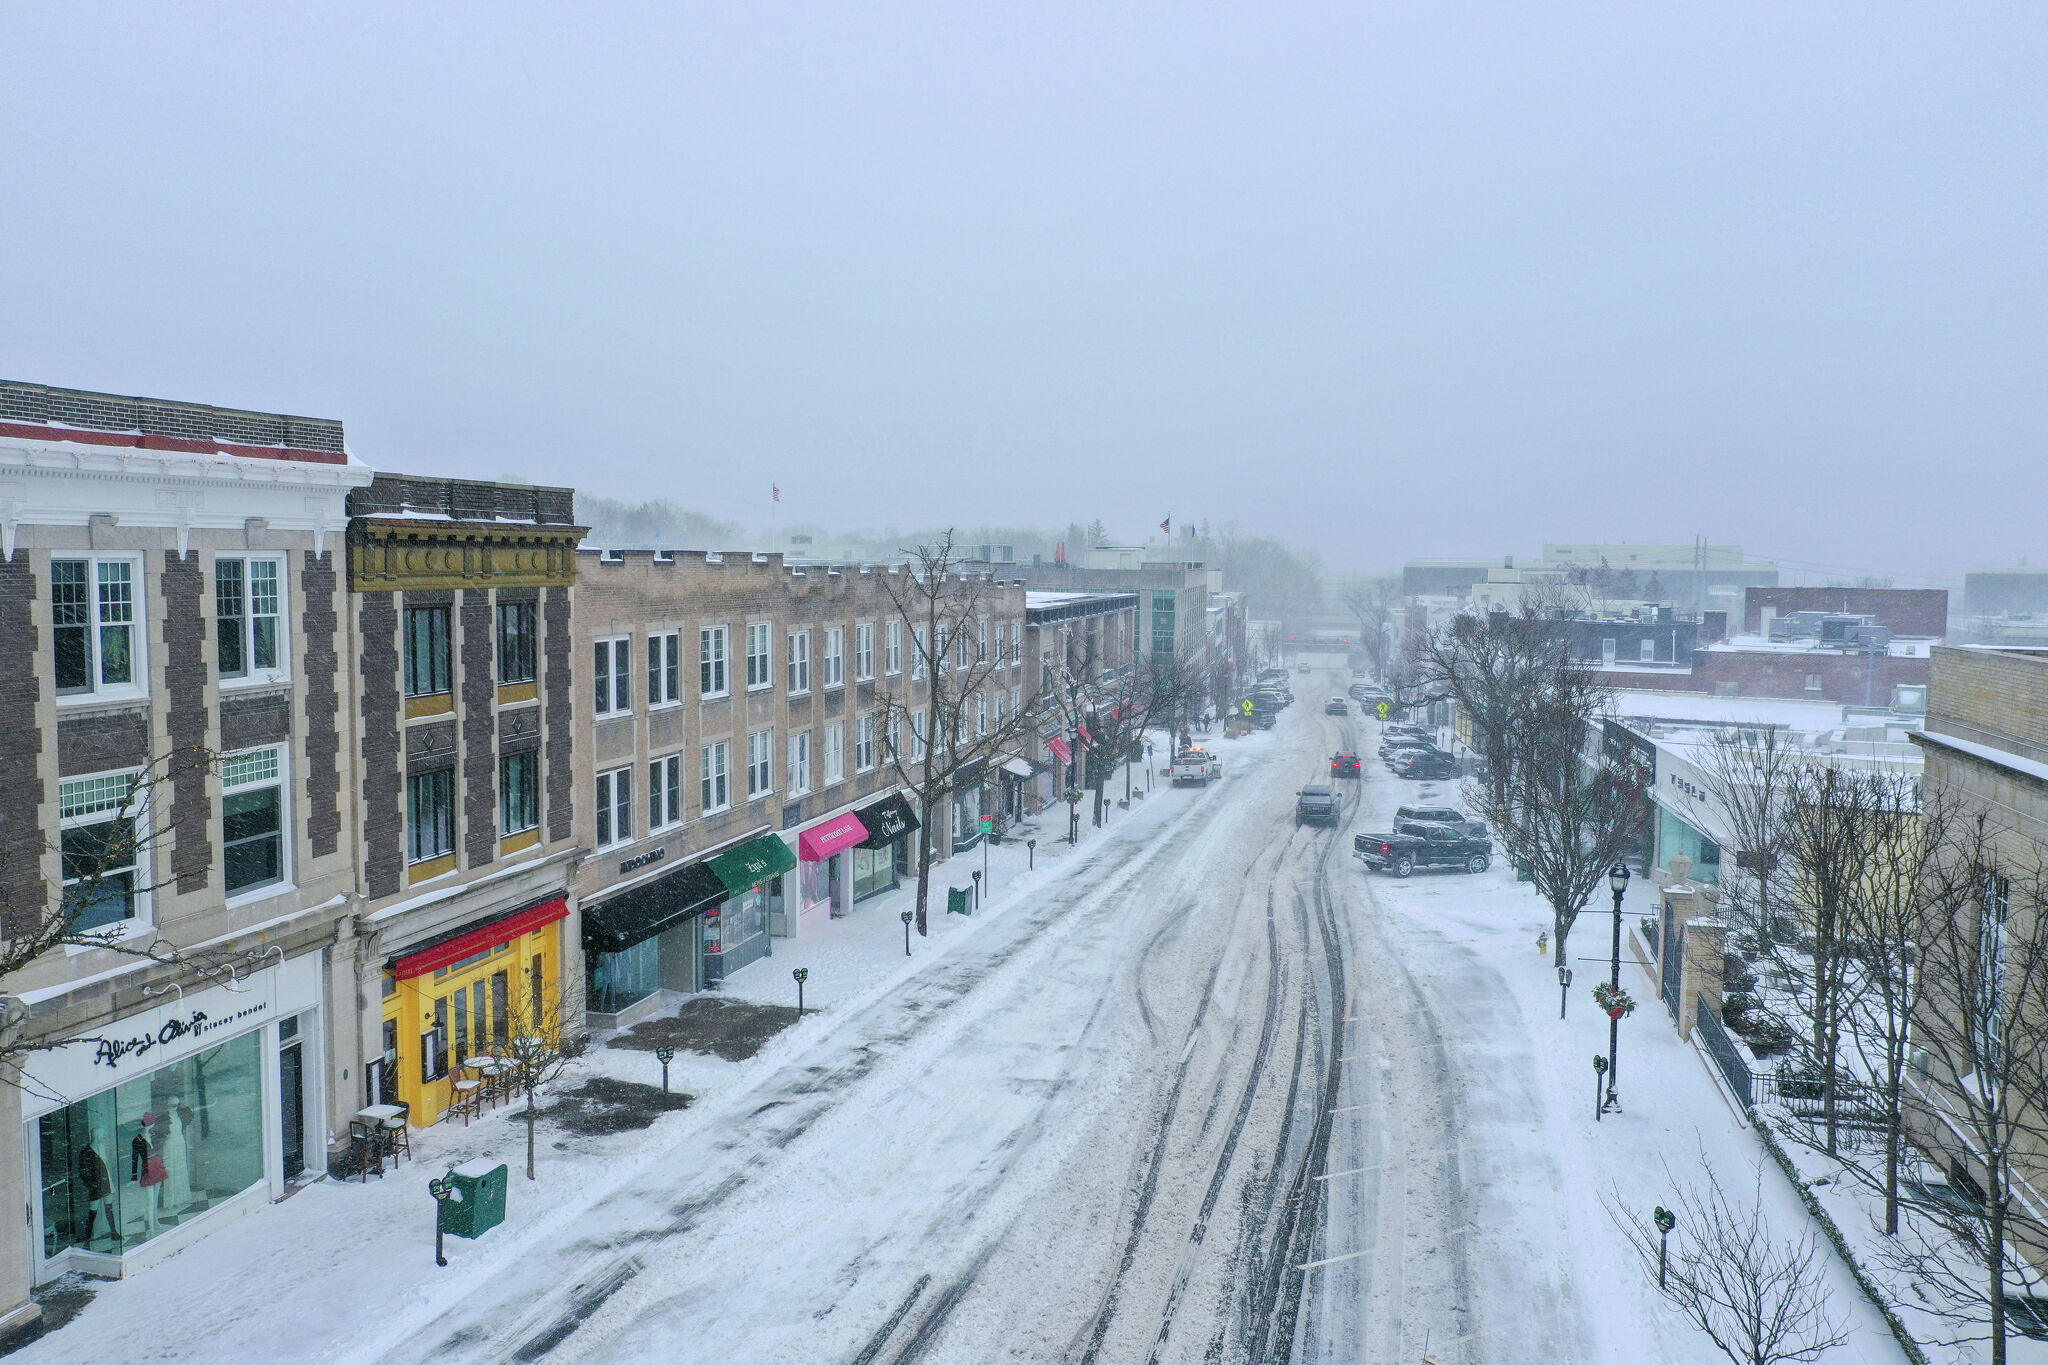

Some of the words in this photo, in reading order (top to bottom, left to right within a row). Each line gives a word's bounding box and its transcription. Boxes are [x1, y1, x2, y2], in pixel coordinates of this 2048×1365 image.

[1671, 774, 1705, 802] TESLA
[881, 817, 905, 836] Nails
[94, 1036, 145, 1067] Alice
[158, 1011, 207, 1044] Olivia
[204, 1015, 233, 1032] stacey
[237, 1002, 267, 1019] bendet
